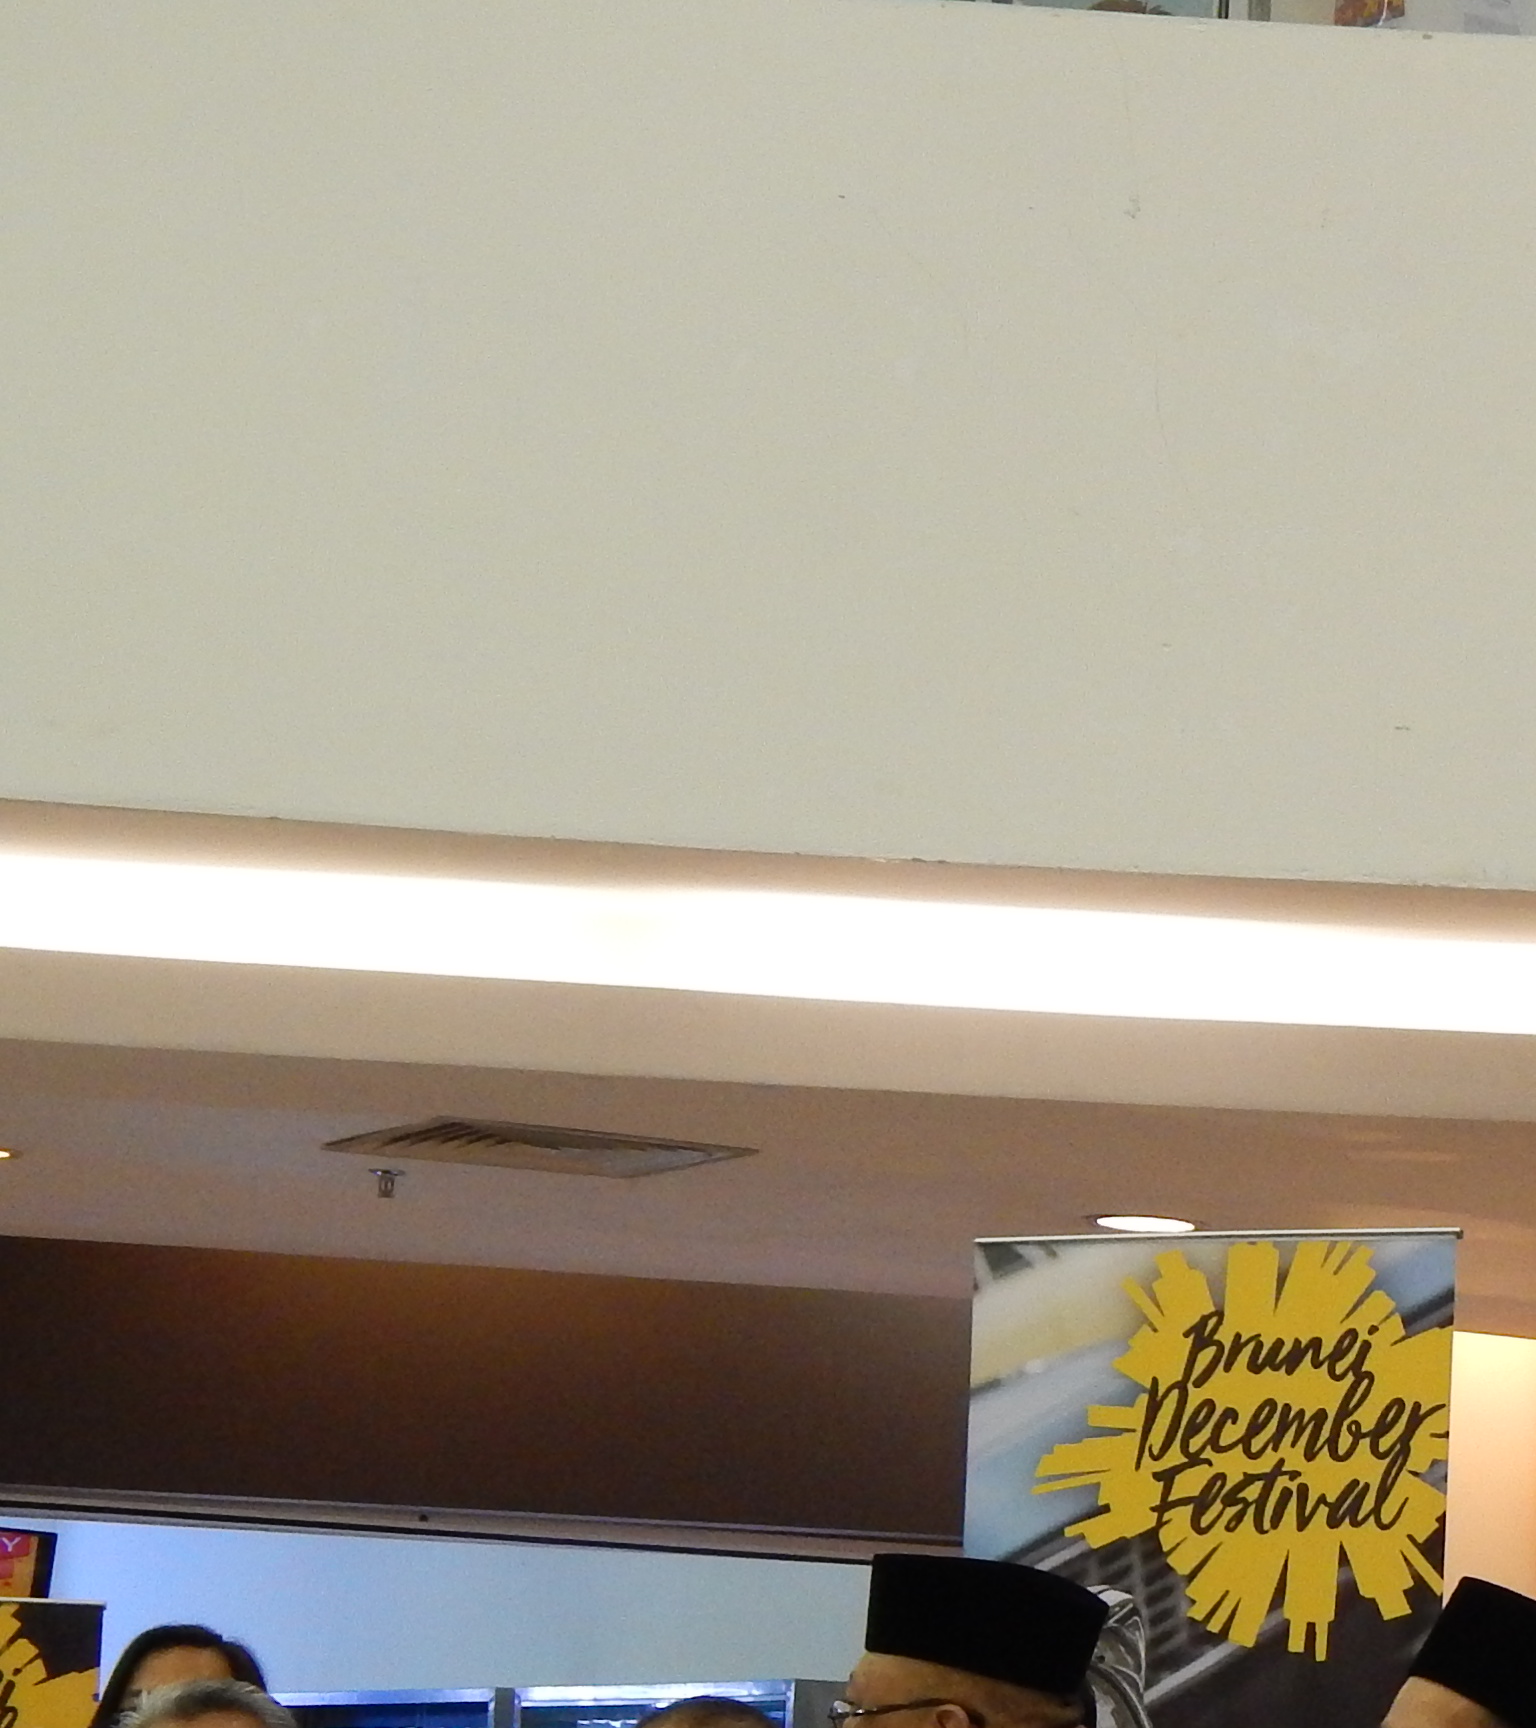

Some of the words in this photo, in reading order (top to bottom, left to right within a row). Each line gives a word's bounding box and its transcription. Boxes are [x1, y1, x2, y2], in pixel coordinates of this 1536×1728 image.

[1182, 1309, 1380, 1389] Brunei
[1134, 1371, 1447, 1471] December
[1149, 1443, 1409, 1535] Festival
